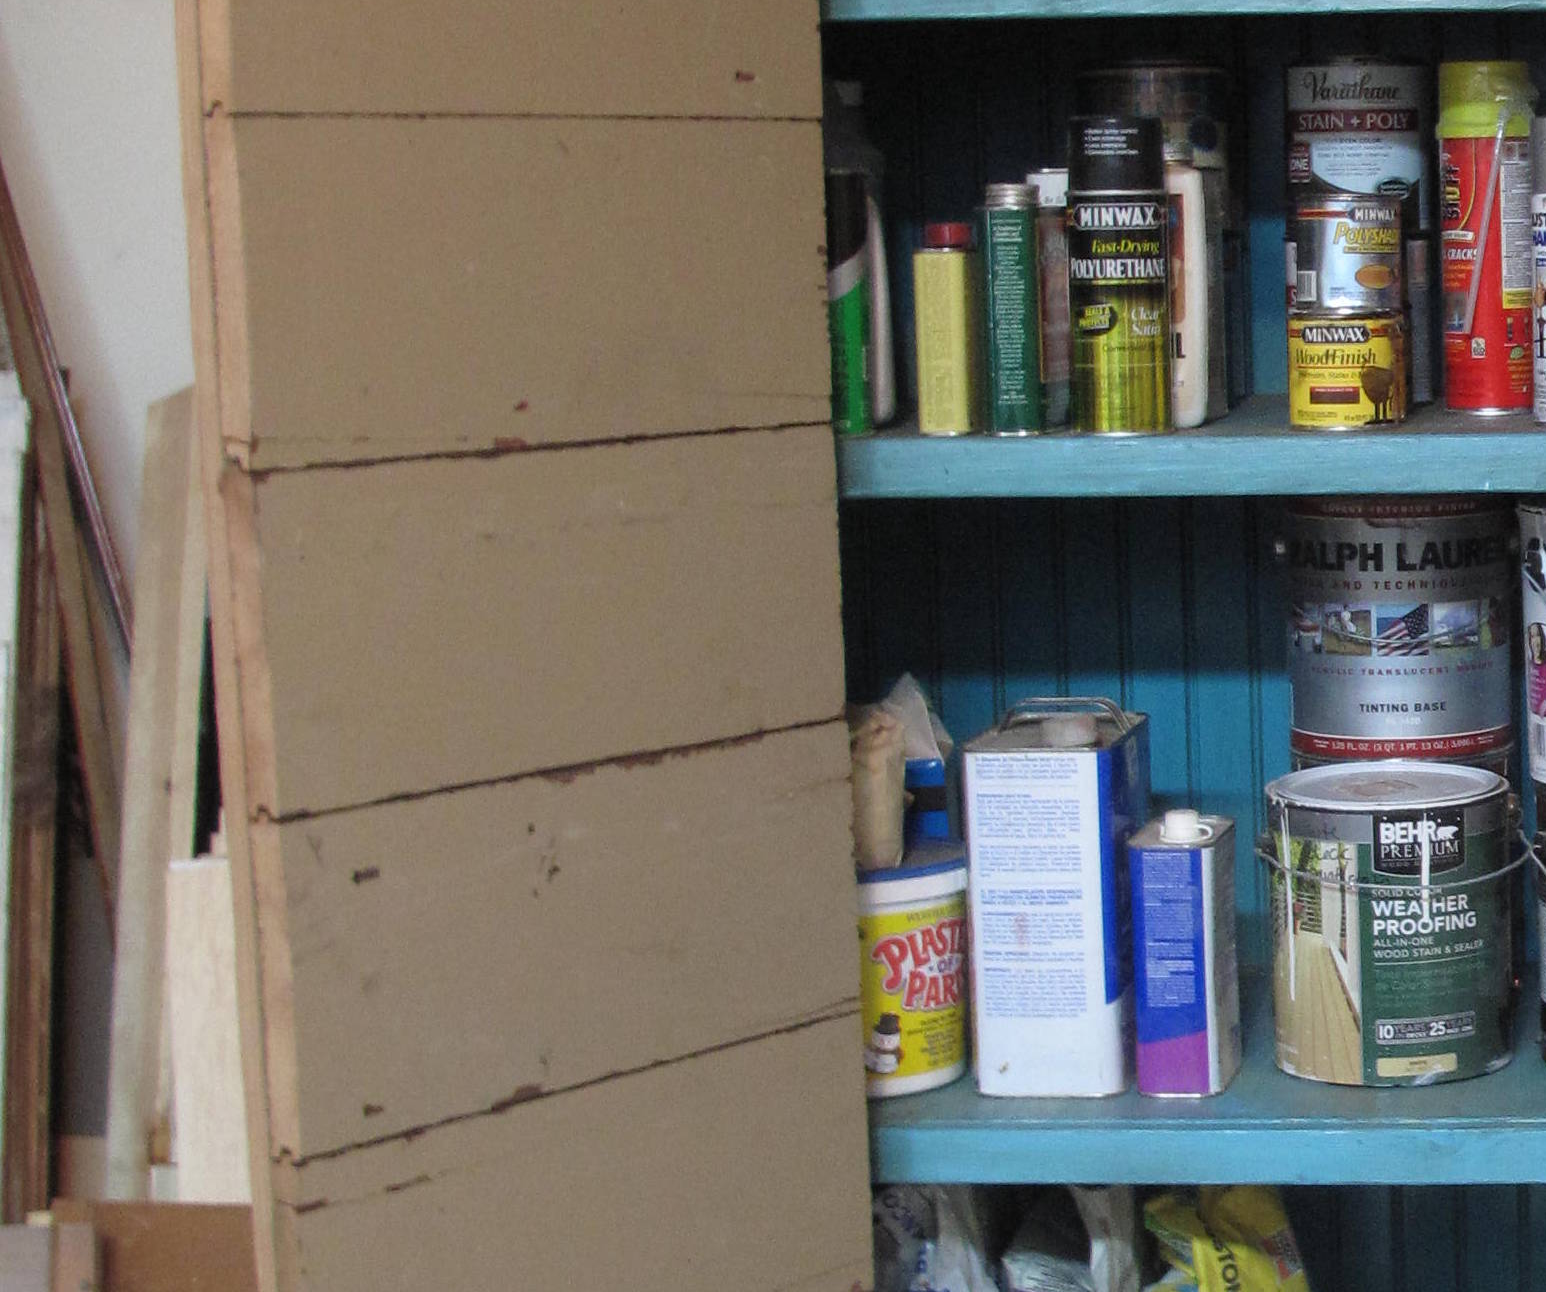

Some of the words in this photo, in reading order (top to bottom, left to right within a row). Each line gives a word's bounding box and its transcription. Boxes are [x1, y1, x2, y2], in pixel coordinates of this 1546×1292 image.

[1299, 112, 1344, 129] STAIN
[1366, 112, 1409, 129] POLY
[1079, 206, 1156, 228] MINWAX
[1354, 208, 1396, 222] MINWAX
[1091, 239, 1160, 256] Fast-Drying
[1070, 257, 1166, 279] POLYURETHANE
[1131, 306, 1160, 321] Clear
[1131, 321, 1161, 336] Satin
[1304, 327, 1367, 342] MINWAX
[1293, 541, 1384, 572] ALPH
[1396, 539, 1500, 572] LAUR
[1359, 702, 1409, 713] TINTING
[1414, 701, 1447, 712] BASE
[1379, 820, 1437, 844] BEHR
[1380, 839, 1460, 859] PREMUM
[1371, 888, 1404, 898] SOLID
[1406, 887, 1443, 898] COOR
[1373, 911, 1477, 936] PROOFING
[1373, 937, 1435, 948] ALL-IN-ONE
[1374, 949, 1410, 959] WOOD
[1412, 946, 1442, 957] STAIN
[1454, 939, 1484, 952] SEALER
[872, 917, 965, 991] PLAST
[904, 967, 963, 1008] PAR
[1378, 1024, 1395, 1039] 10
[1429, 1021, 1446, 1037] 25
